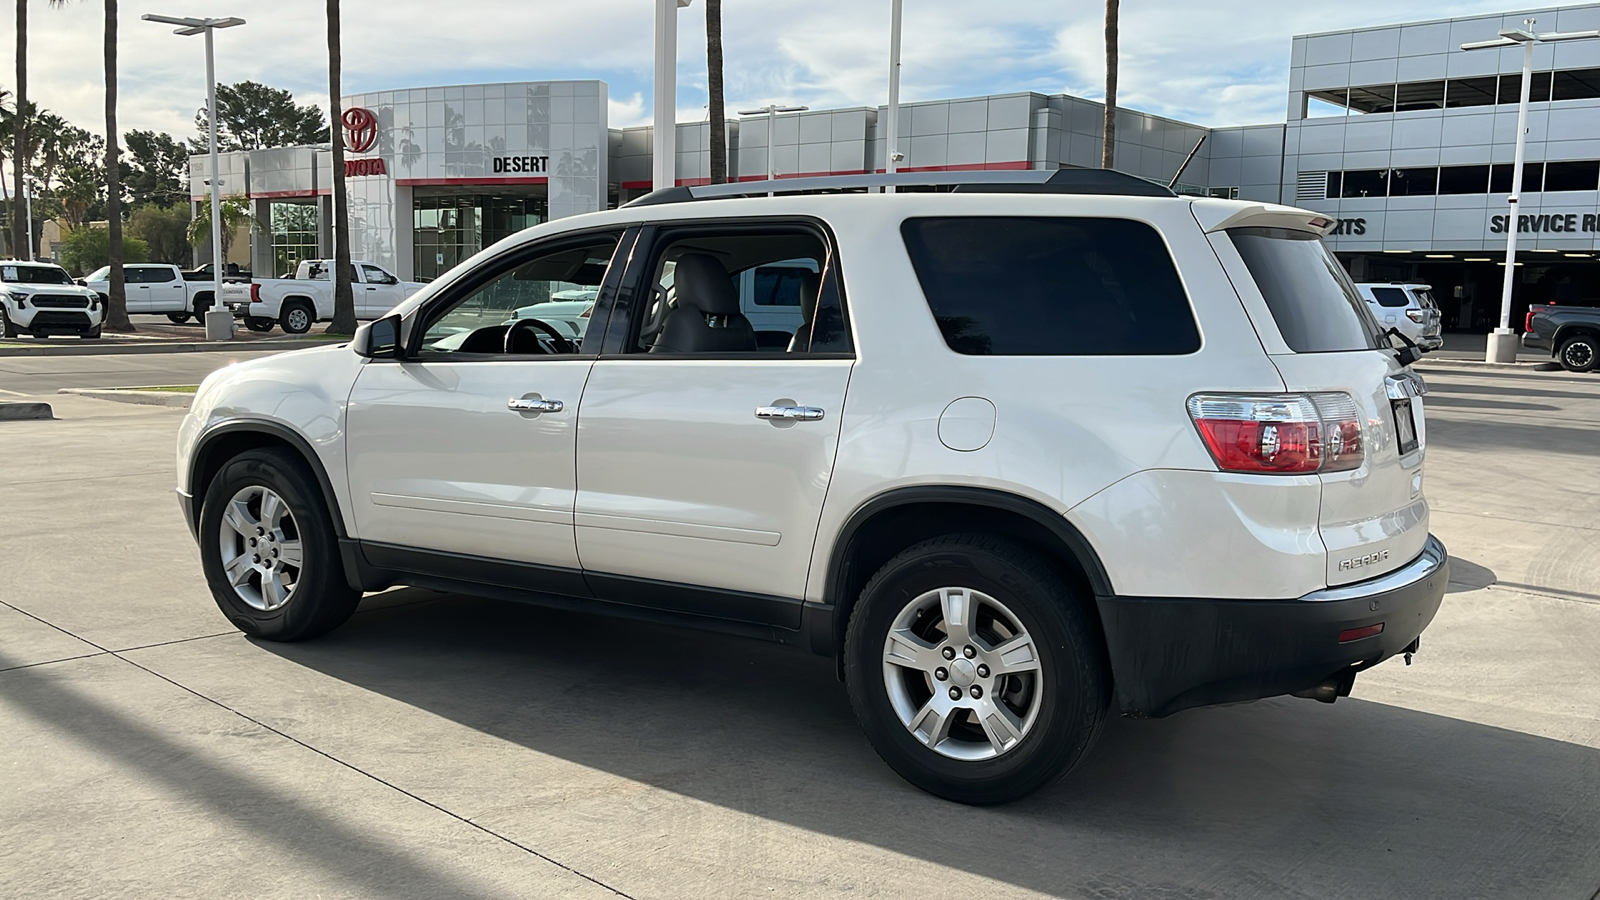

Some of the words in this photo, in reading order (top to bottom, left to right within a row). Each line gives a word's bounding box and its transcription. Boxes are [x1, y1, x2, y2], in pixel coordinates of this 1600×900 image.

[344, 158, 387, 177] OYOTA
[493, 156, 549, 173] DESERT
[1338, 548, 1389, 572] ACADIA
